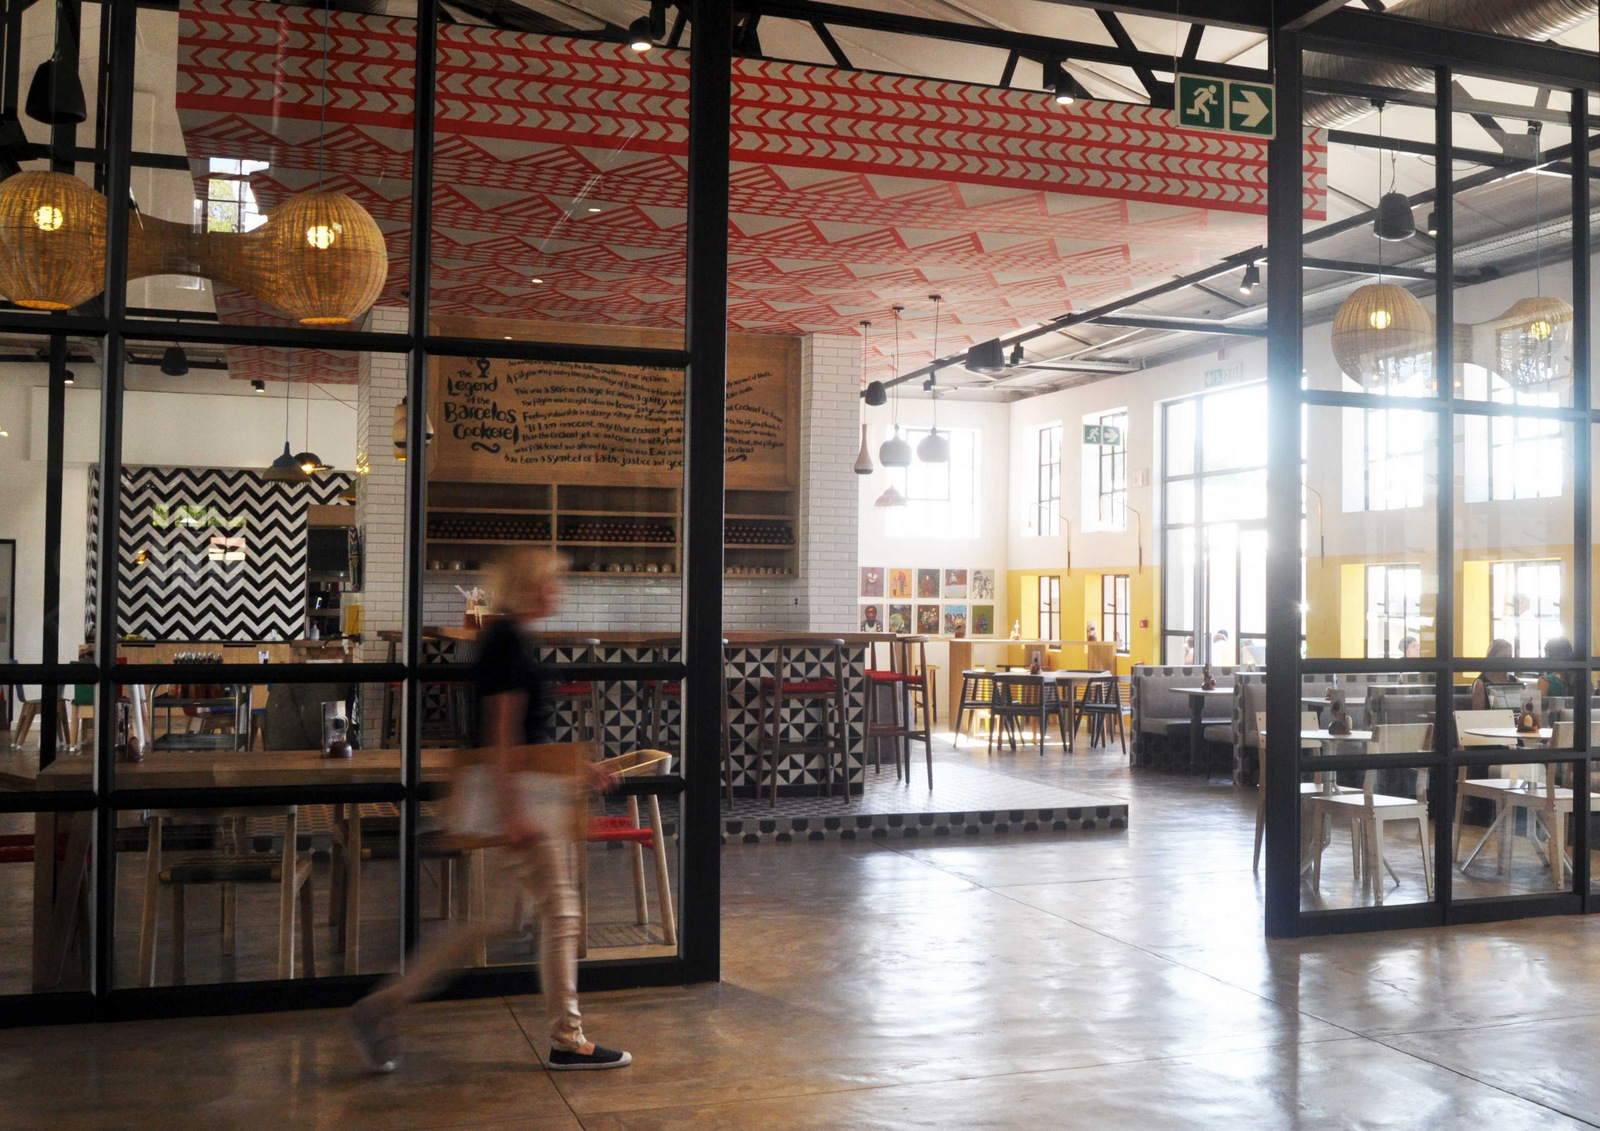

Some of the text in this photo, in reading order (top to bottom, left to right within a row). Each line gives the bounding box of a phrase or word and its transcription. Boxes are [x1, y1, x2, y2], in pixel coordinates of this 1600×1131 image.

[456, 370, 472, 378] The
[506, 374, 513, 385] A
[1224, 366, 1240, 382] EXIT
[447, 376, 498, 398] Legend
[466, 395, 490, 405] of the
[514, 387, 528, 396] This
[606, 388, 615, 396] for
[642, 396, 668, 409] guilty
[444, 400, 516, 424] Barcelos
[453, 421, 518, 445] Cockerel
[597, 422, 613, 432] may
[614, 424, 630, 433] that
[522, 433, 538, 442] than
[538, 432, 550, 440] the
[504, 452, 518, 463] has
[520, 455, 538, 464] been
[546, 452, 581, 466] symbol
[582, 454, 592, 463] of
[620, 453, 651, 467] justice
